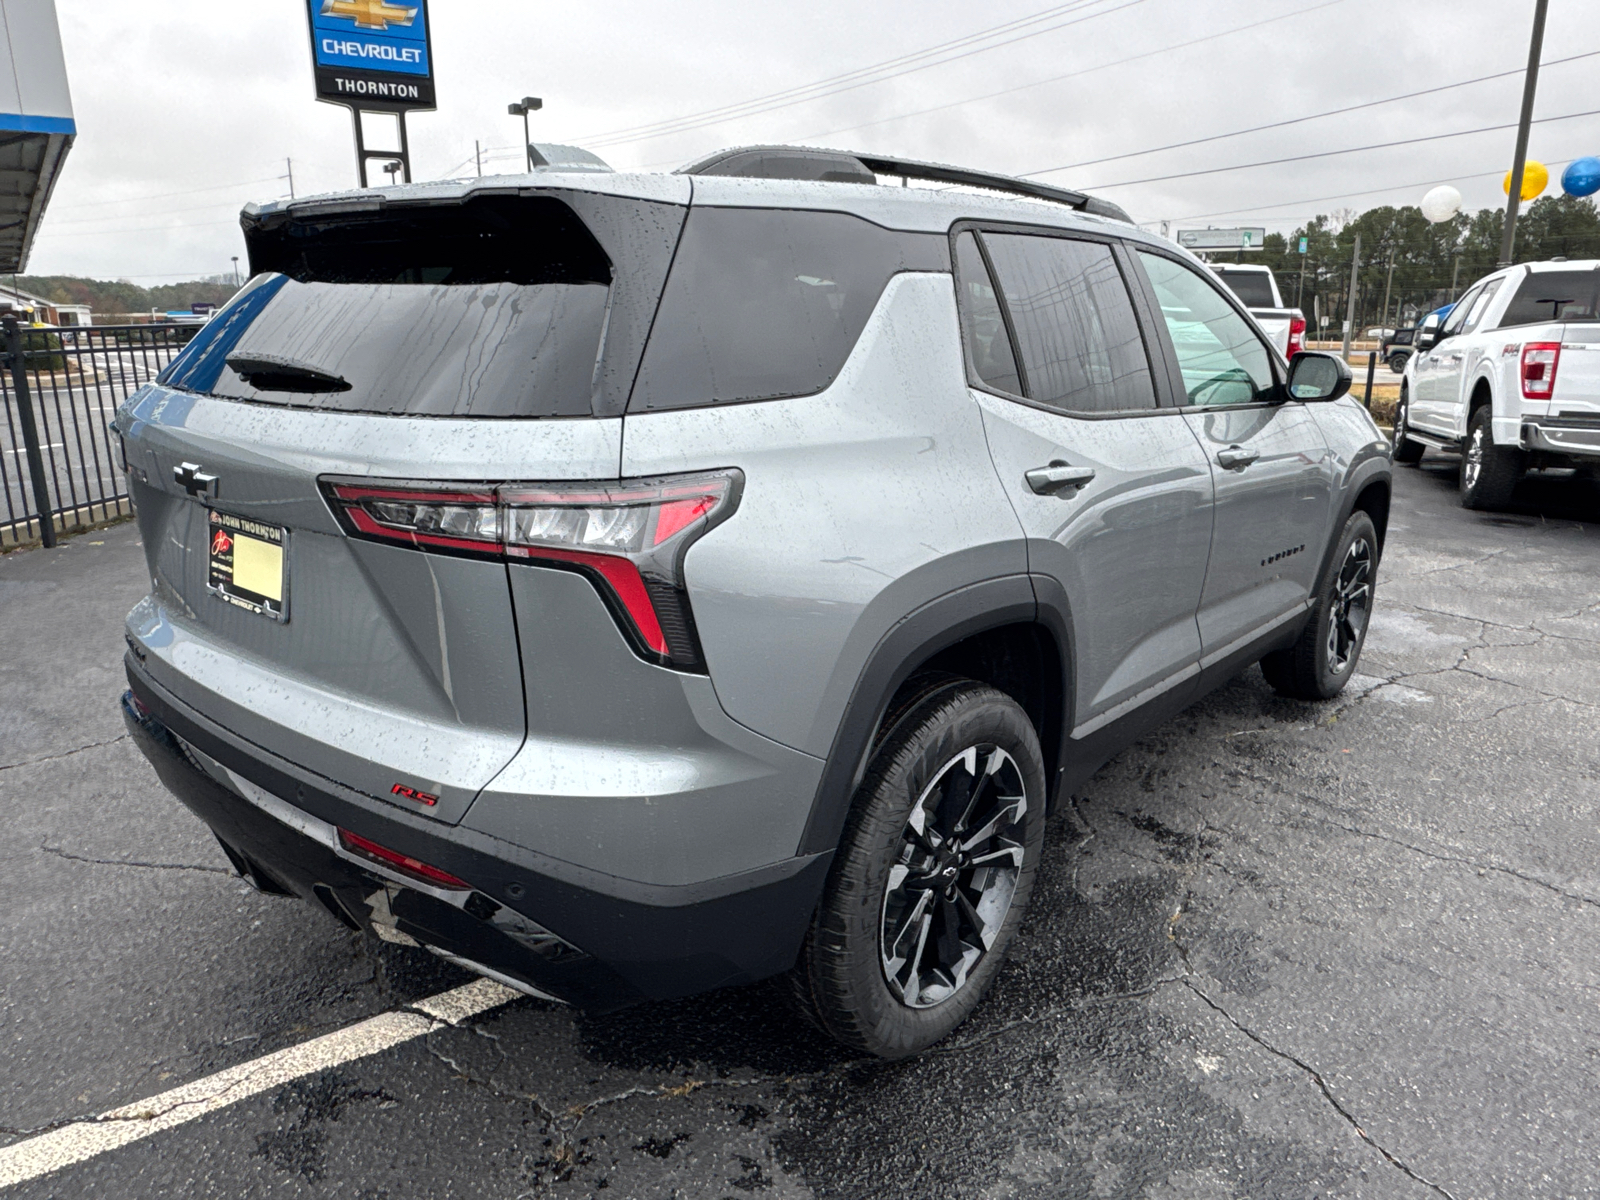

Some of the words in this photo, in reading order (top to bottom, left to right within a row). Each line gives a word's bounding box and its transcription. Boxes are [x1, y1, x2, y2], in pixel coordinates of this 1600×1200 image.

[322, 39, 422, 63] CHEVROLET
[335, 78, 419, 98] THORNTON
[222, 514, 241, 530] JOHN
[240, 520, 281, 541] THORNTON
[391, 782, 440, 807] RS
